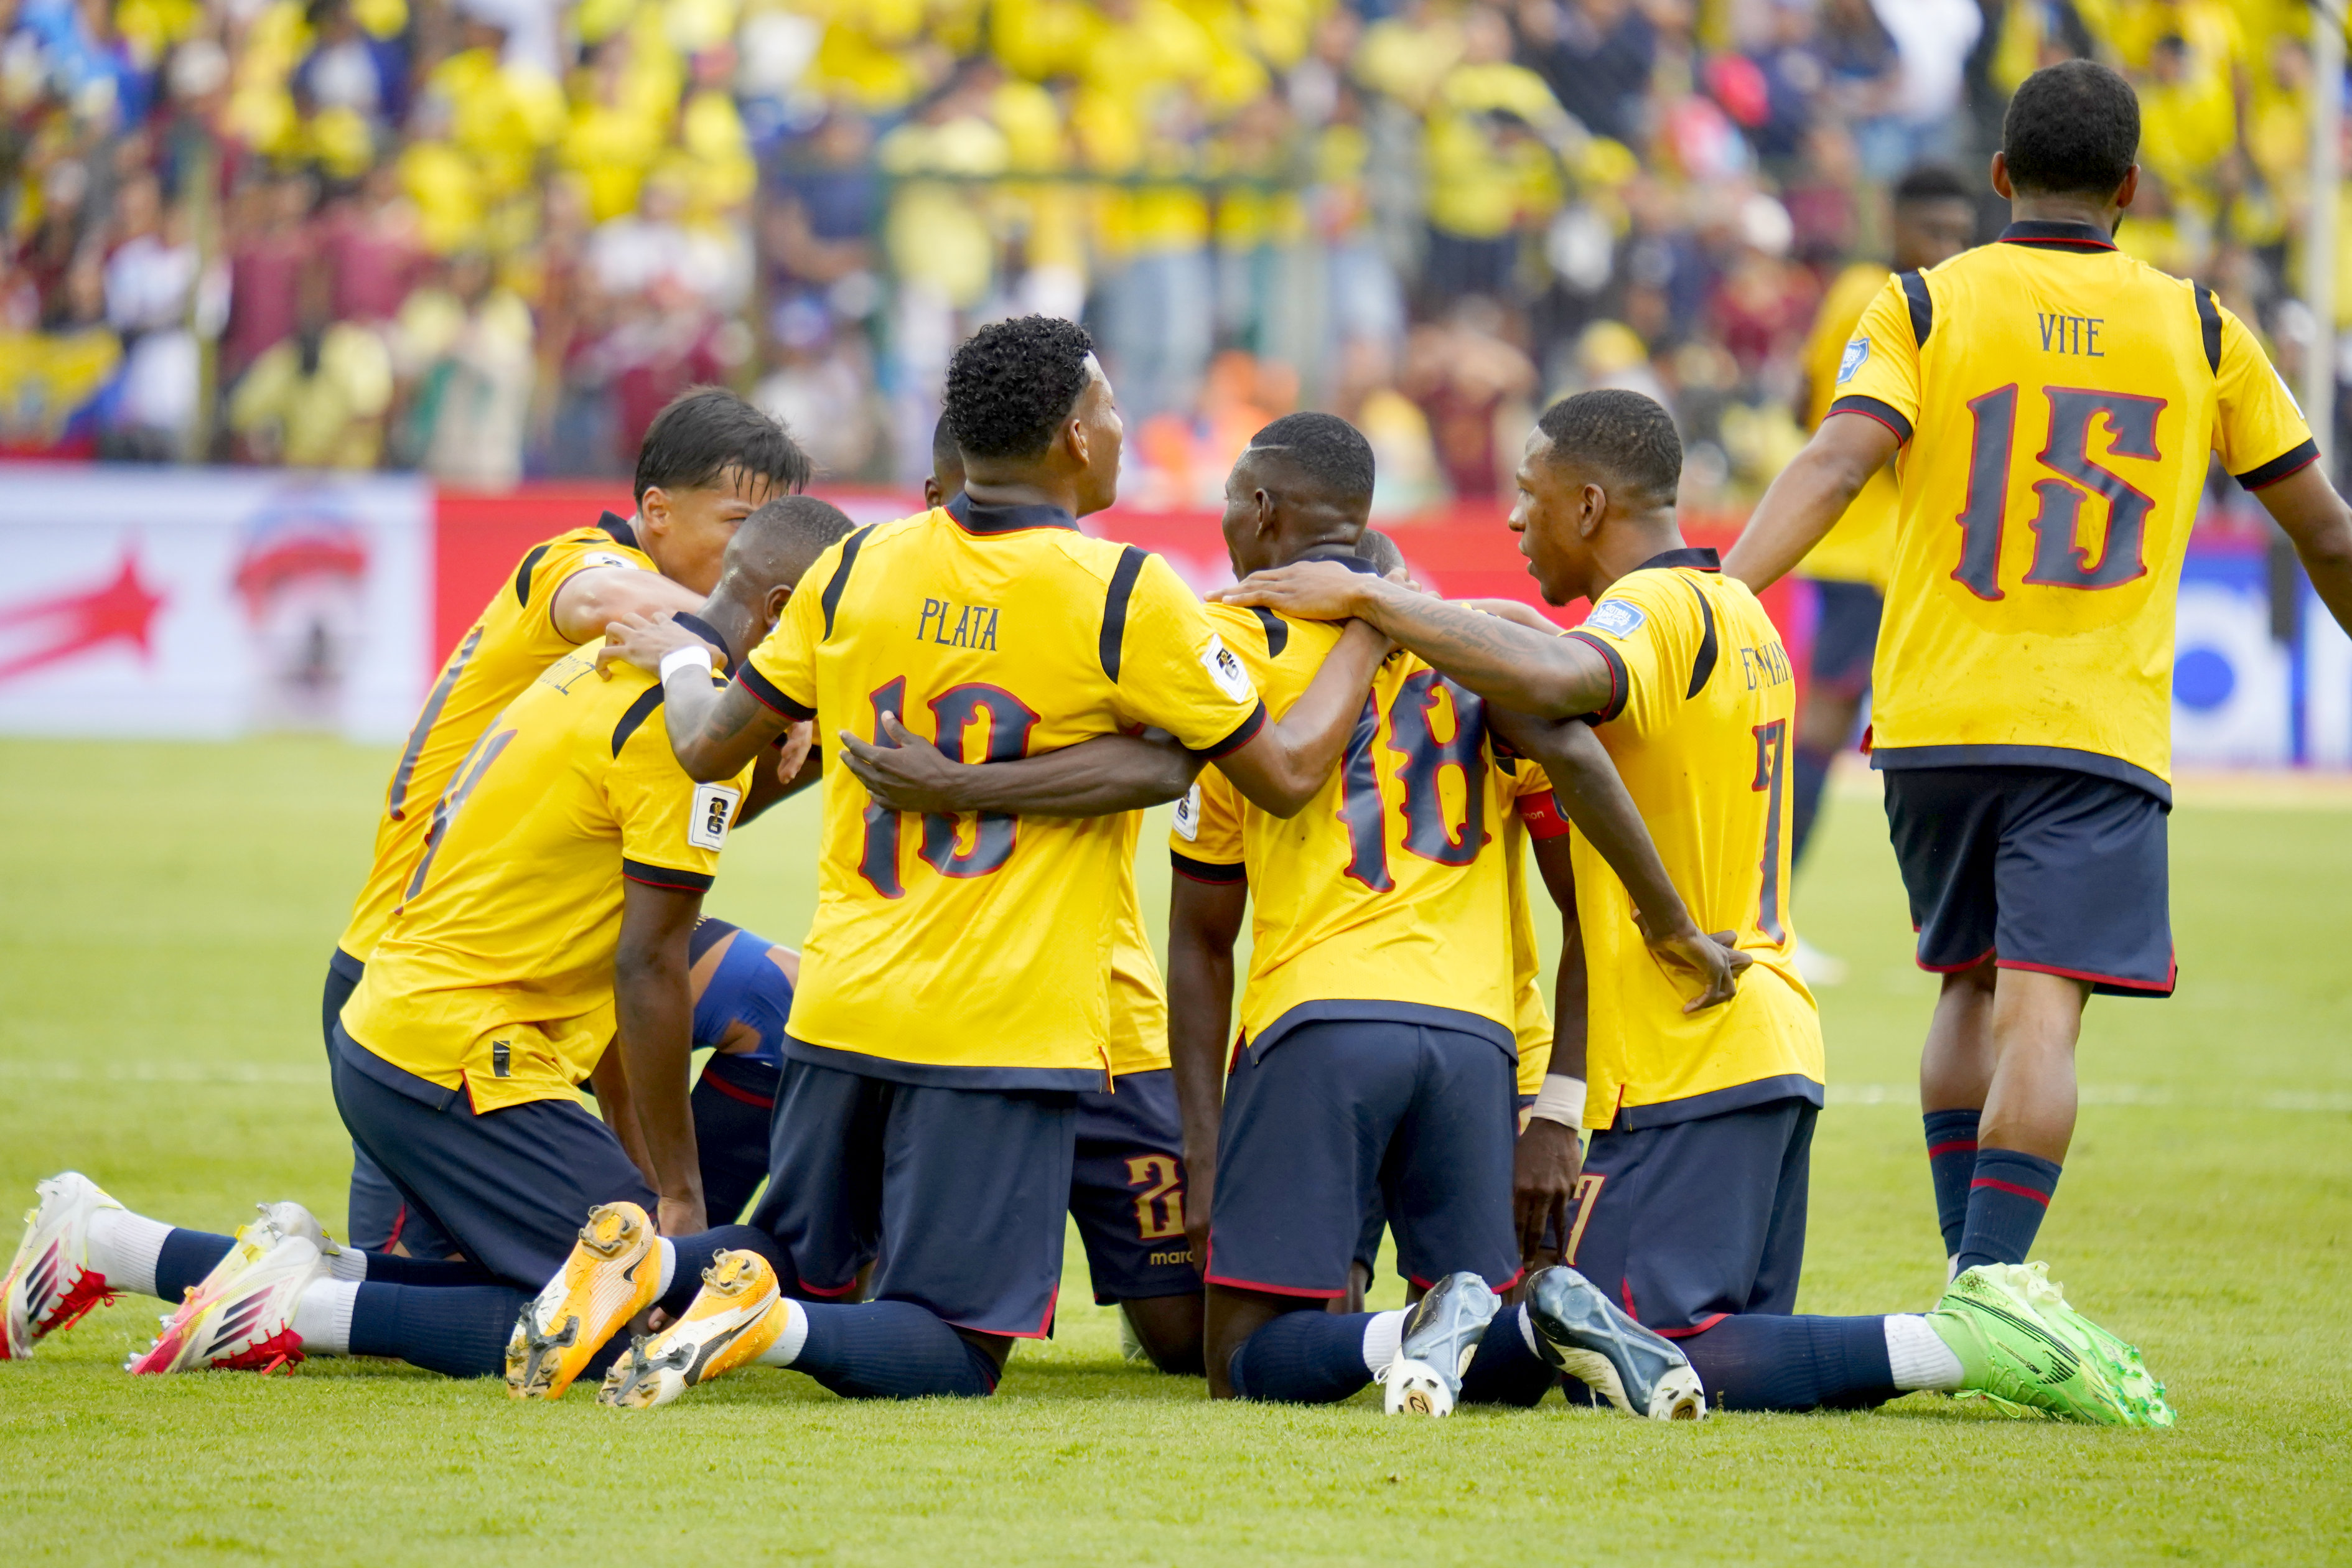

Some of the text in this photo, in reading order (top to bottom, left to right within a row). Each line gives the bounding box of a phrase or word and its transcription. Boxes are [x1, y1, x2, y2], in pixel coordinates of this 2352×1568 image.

[2038, 313, 2104, 357] VITE
[1951, 383, 2168, 601] 15
[916, 598, 1000, 651] PLATA
[1337, 670, 1492, 894] 18
[1752, 718, 1786, 946] 7
